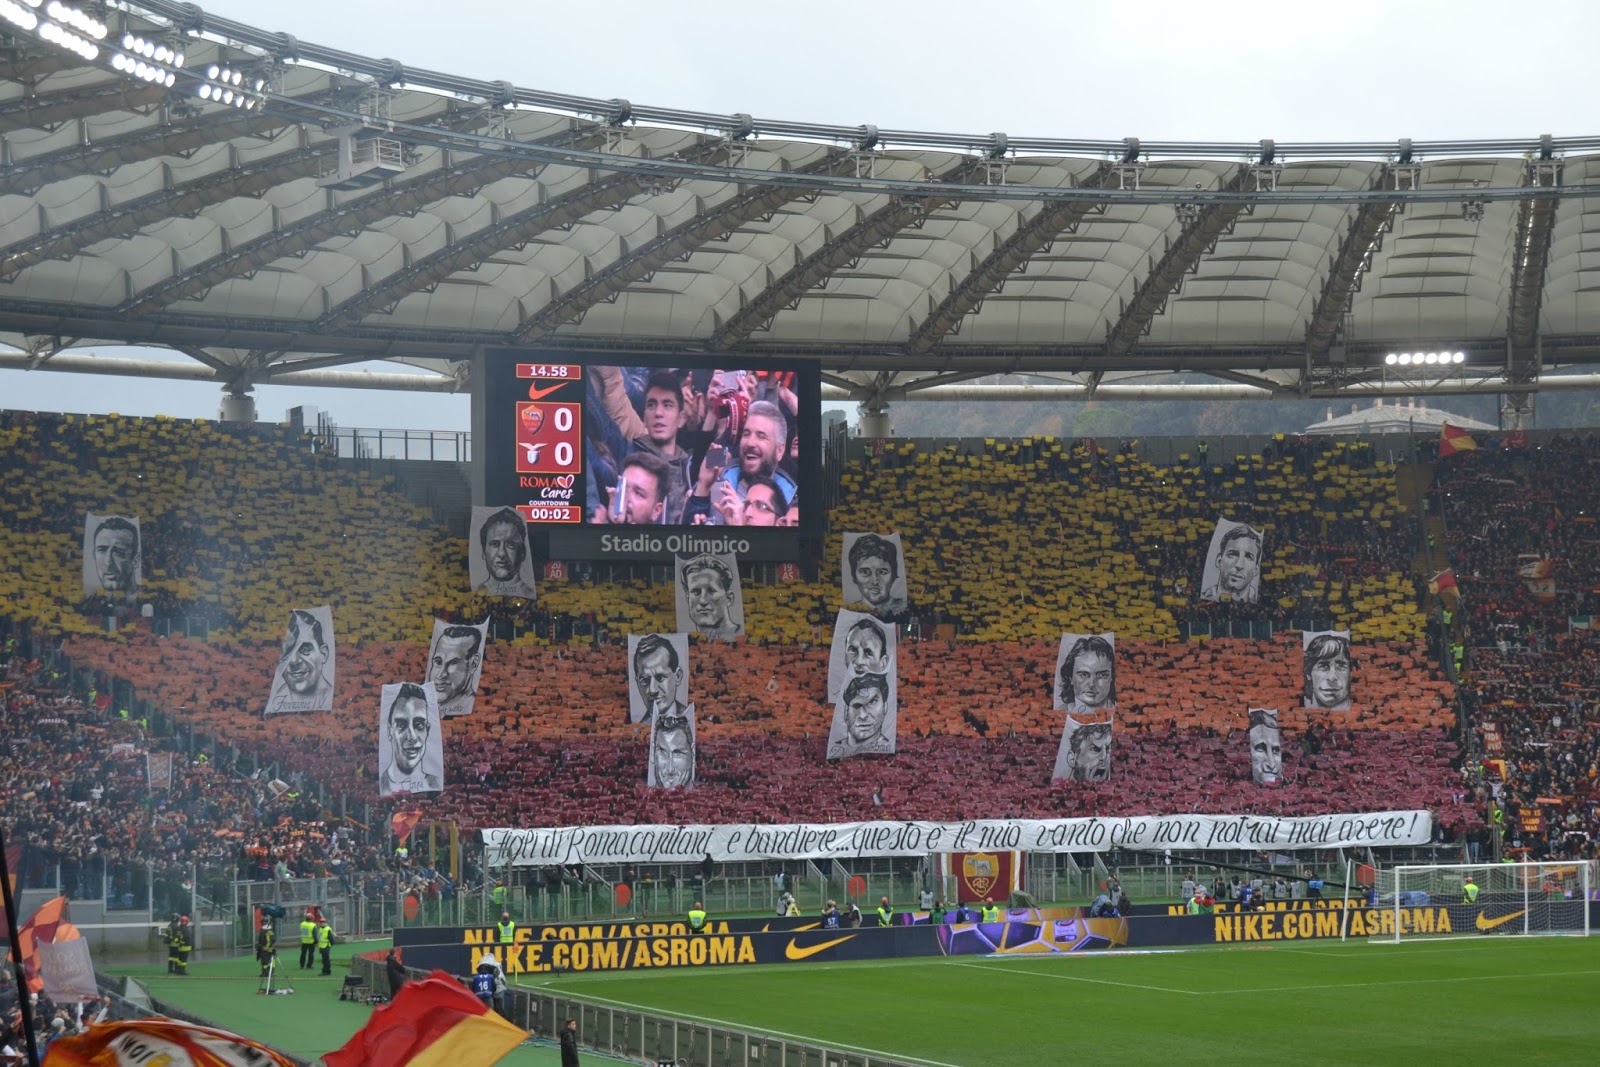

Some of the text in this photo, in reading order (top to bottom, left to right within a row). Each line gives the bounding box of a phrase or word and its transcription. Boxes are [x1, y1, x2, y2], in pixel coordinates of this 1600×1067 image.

[530, 365, 568, 377] 14.58
[554, 407, 573, 432] 0
[554, 441, 573, 467] 0
[519, 476, 559, 488] ROMA
[541, 486, 574, 499] Cares
[531, 508, 570, 519] 00:02
[601, 534, 750, 555] Stadio Olimpico
[541, 828, 564, 859] di
[727, 831, 741, 854] e
[851, 821, 919, 858] questo
[953, 820, 976, 850] il
[978, 820, 1021, 849] mio
[1036, 818, 1106, 847] vanto
[1110, 817, 1147, 844] che
[1152, 819, 1201, 844] non
[1207, 816, 1281, 847] potrai
[1287, 816, 1333, 843] mai
[1338, 812, 1418, 842] avere!
[827, 916, 836, 925] 57
[1215, 907, 1453, 942] NIKE.COM/ASROMA
[471, 935, 757, 975] NIKE.COM/ASROMA
[478, 980, 489, 991] 16
